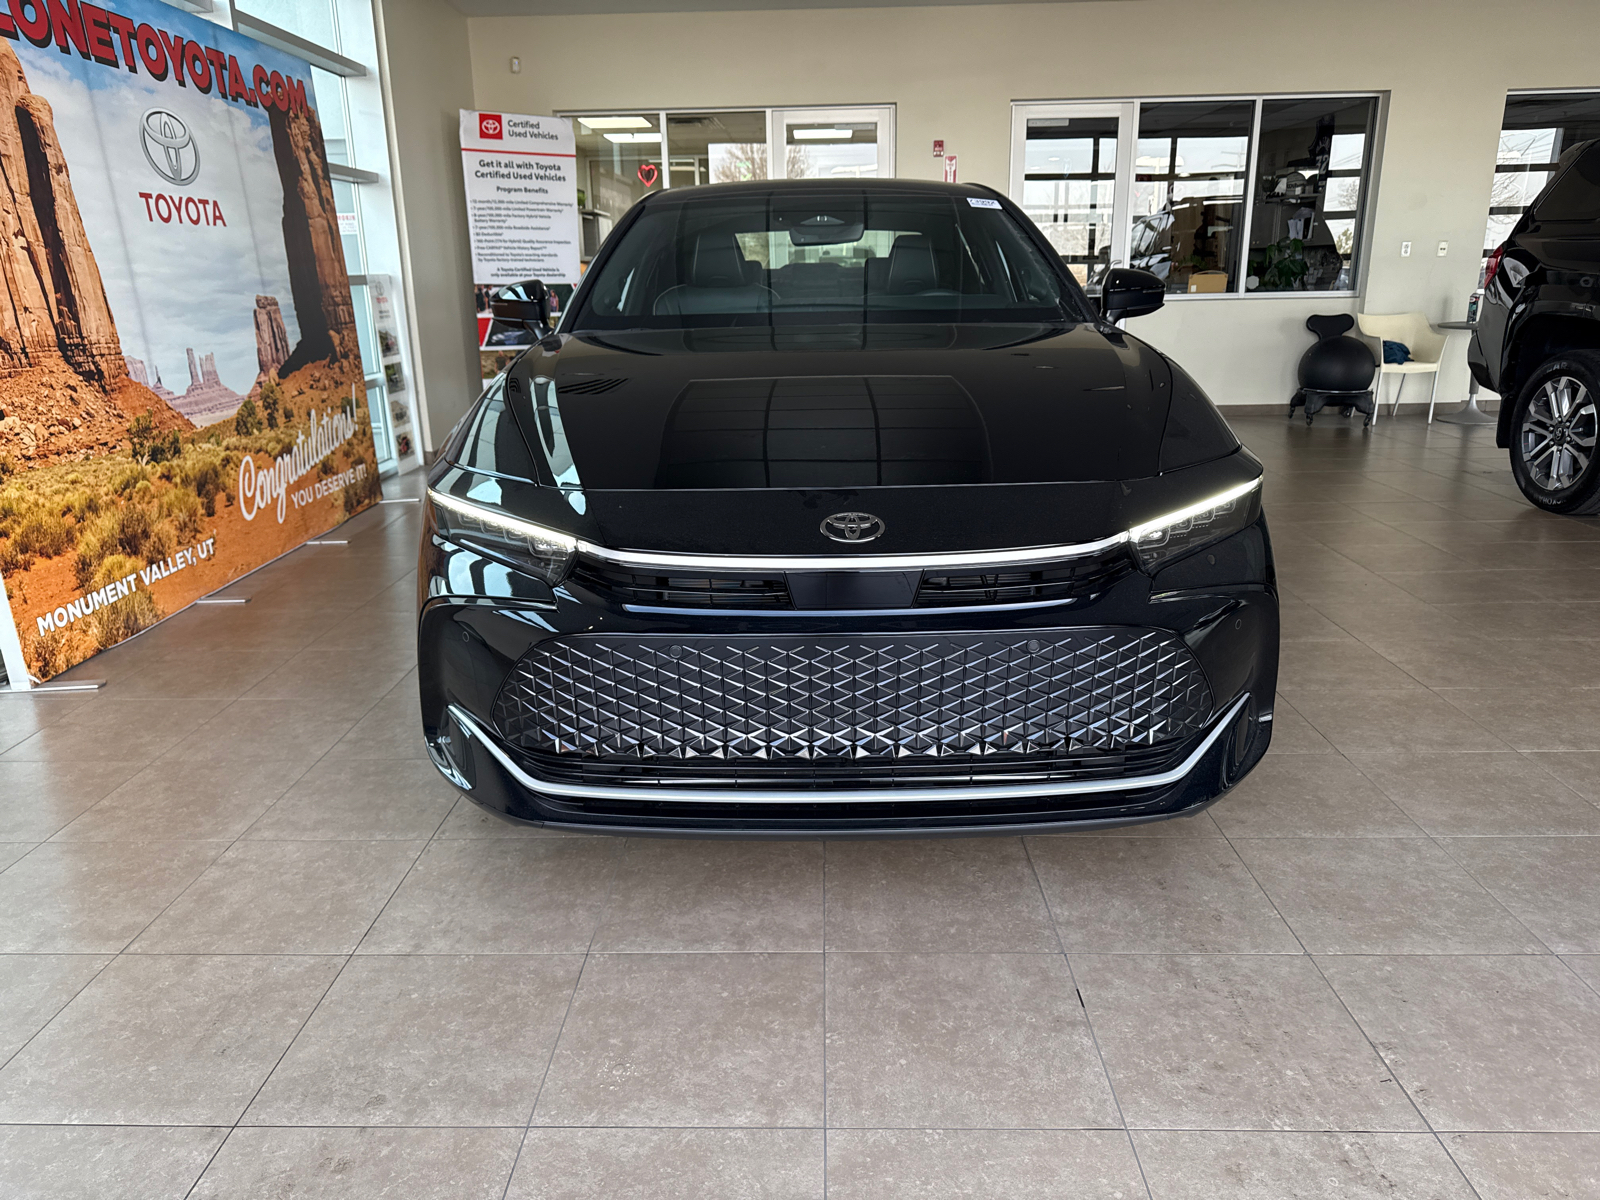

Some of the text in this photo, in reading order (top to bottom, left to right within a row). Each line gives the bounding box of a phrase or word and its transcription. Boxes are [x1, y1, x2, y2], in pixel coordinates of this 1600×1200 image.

[0, 0, 310, 119] ONETOYOTA.COM
[508, 119, 540, 129] Certified
[508, 129, 558, 140] Used Vehicles
[475, 170, 566, 182] Certified Used Vehicles
[479, 160, 561, 172] Get it all with Toyota
[496, 186, 523, 195] Program
[138, 192, 227, 227] TOYOTA
[239, 382, 358, 524] Congratulations!
[291, 463, 367, 509] YOU DESERVE IT!
[36, 538, 215, 637] MONUMENT VALLEY, UT
